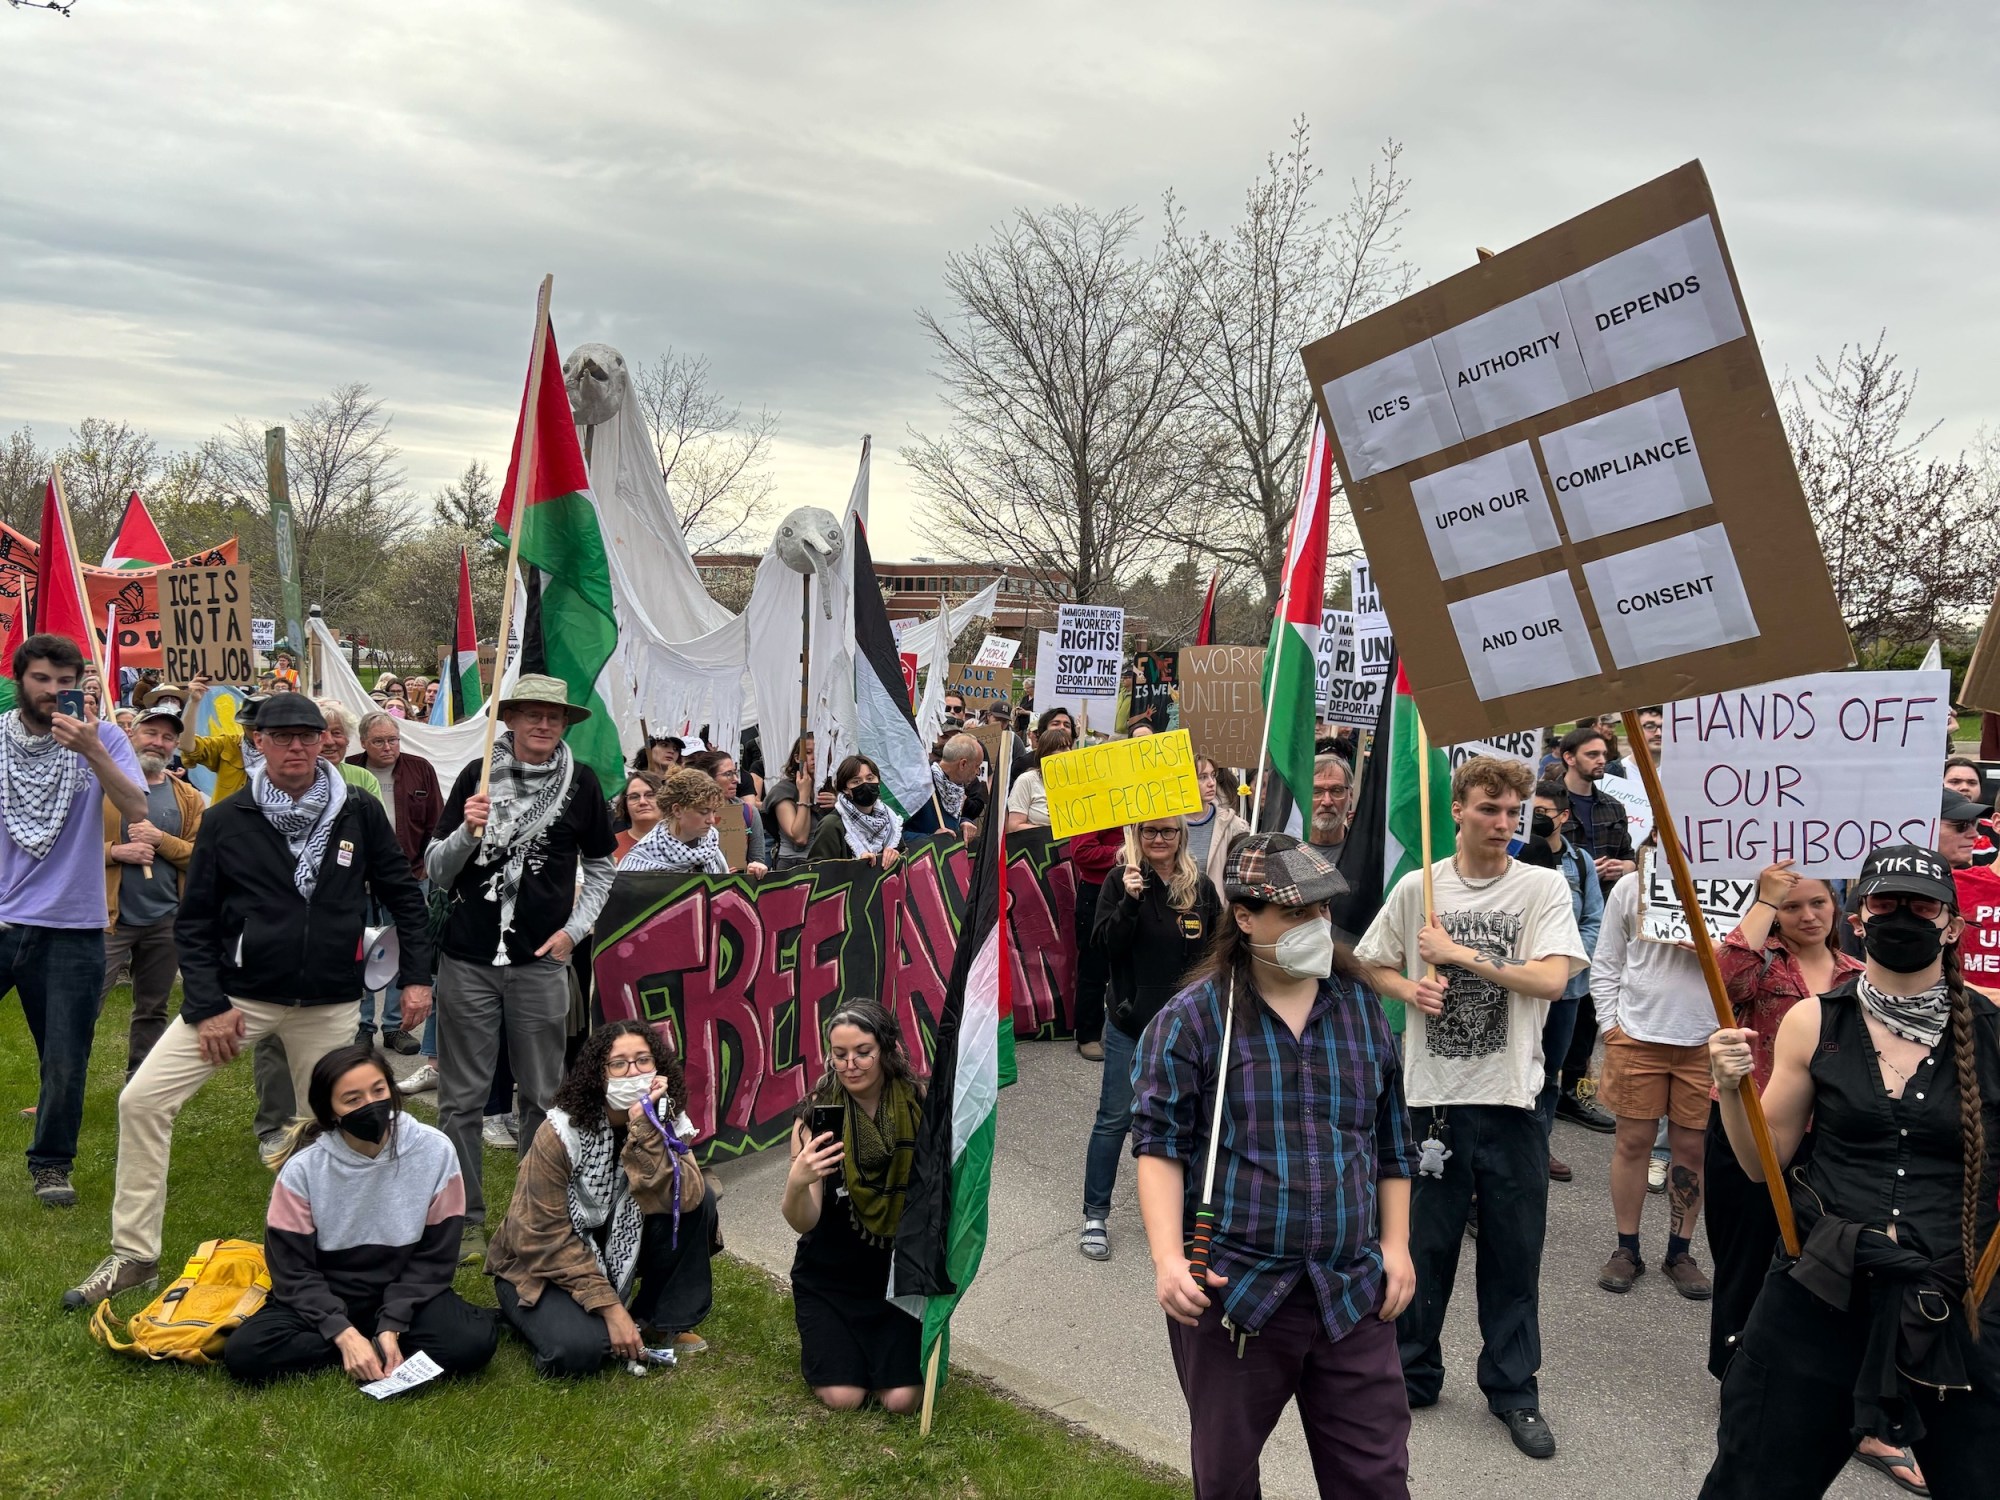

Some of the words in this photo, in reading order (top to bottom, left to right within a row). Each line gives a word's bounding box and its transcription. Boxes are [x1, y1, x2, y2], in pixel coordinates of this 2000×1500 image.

[1368, 396, 1410, 423] ICE'S
[1457, 332, 1561, 388] AUTHORITY
[1595, 276, 1701, 331] DEPENDS
[1435, 502, 1486, 530] UPON
[1488, 488, 1530, 513] OUR
[1555, 436, 1691, 493] COMPLIANCE
[168, 574, 201, 606] ICE
[206, 570, 238, 604] IS
[174, 607, 220, 645] NOT
[227, 608, 242, 642] A
[1062, 607, 1098, 618] IMMIGRANT
[1100, 610, 1121, 619] RIGHTS
[1062, 619, 1073, 627] ARE
[1075, 618, 1121, 631] WORKER'S
[1482, 630, 1517, 652] AND
[1521, 618, 1563, 641] OUR
[1616, 575, 1715, 615] CONSENT
[982, 648, 1008, 661] MORAL
[1060, 629, 1119, 651] RIGHTS!
[167, 647, 212, 682] REAL
[214, 648, 251, 682] JOB
[964, 668, 996, 682] DUE
[1056, 675, 1117, 687] DEPORTATIONS!
[1058, 654, 1093, 675] STOP
[1097, 659, 1117, 675] THE
[949, 683, 1009, 700] PROCESS
[1181, 680, 1263, 714] UNITED
[1332, 678, 1377, 702] STOP
[1329, 700, 1380, 716] DEPORTAT
[1671, 691, 1816, 743] HANDS
[1839, 697, 1938, 747] OFF
[1043, 747, 1113, 790] COLLECT
[1123, 734, 1192, 772] TRASH
[1704, 764, 1805, 807] OUR
[1055, 793, 1096, 832] NOT
[1109, 774, 1195, 822] PEOPLE
[1875, 856, 1943, 879] YIKES
[594, 884, 847, 1146] FREE
